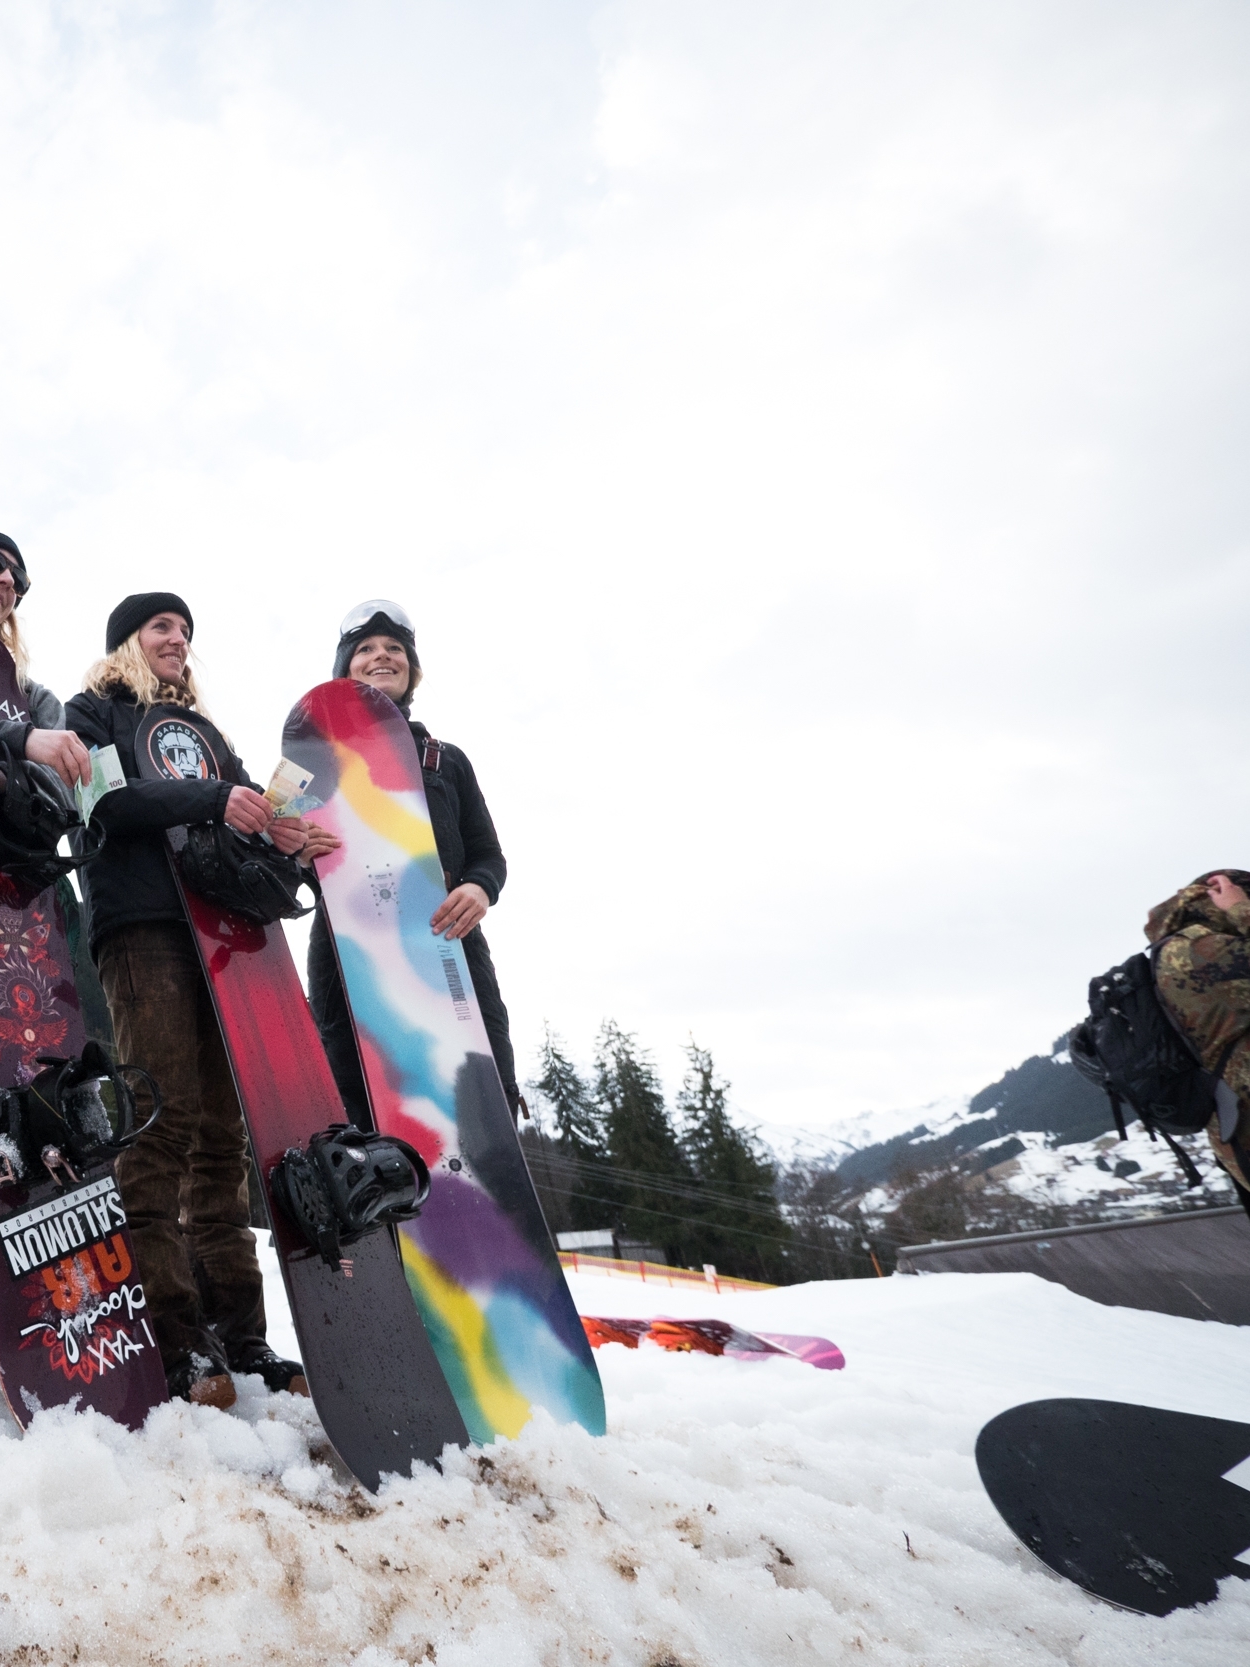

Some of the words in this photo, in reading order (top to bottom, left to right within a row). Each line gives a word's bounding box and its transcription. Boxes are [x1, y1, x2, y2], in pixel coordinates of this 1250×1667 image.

[156, 724, 198, 741] GARAGE
[108, 778, 124, 789] 100
[452, 1000, 472, 1021] RIDE
[3, 1179, 111, 1233] SNOWBOARDS
[3, 1191, 127, 1276] SALOMON
